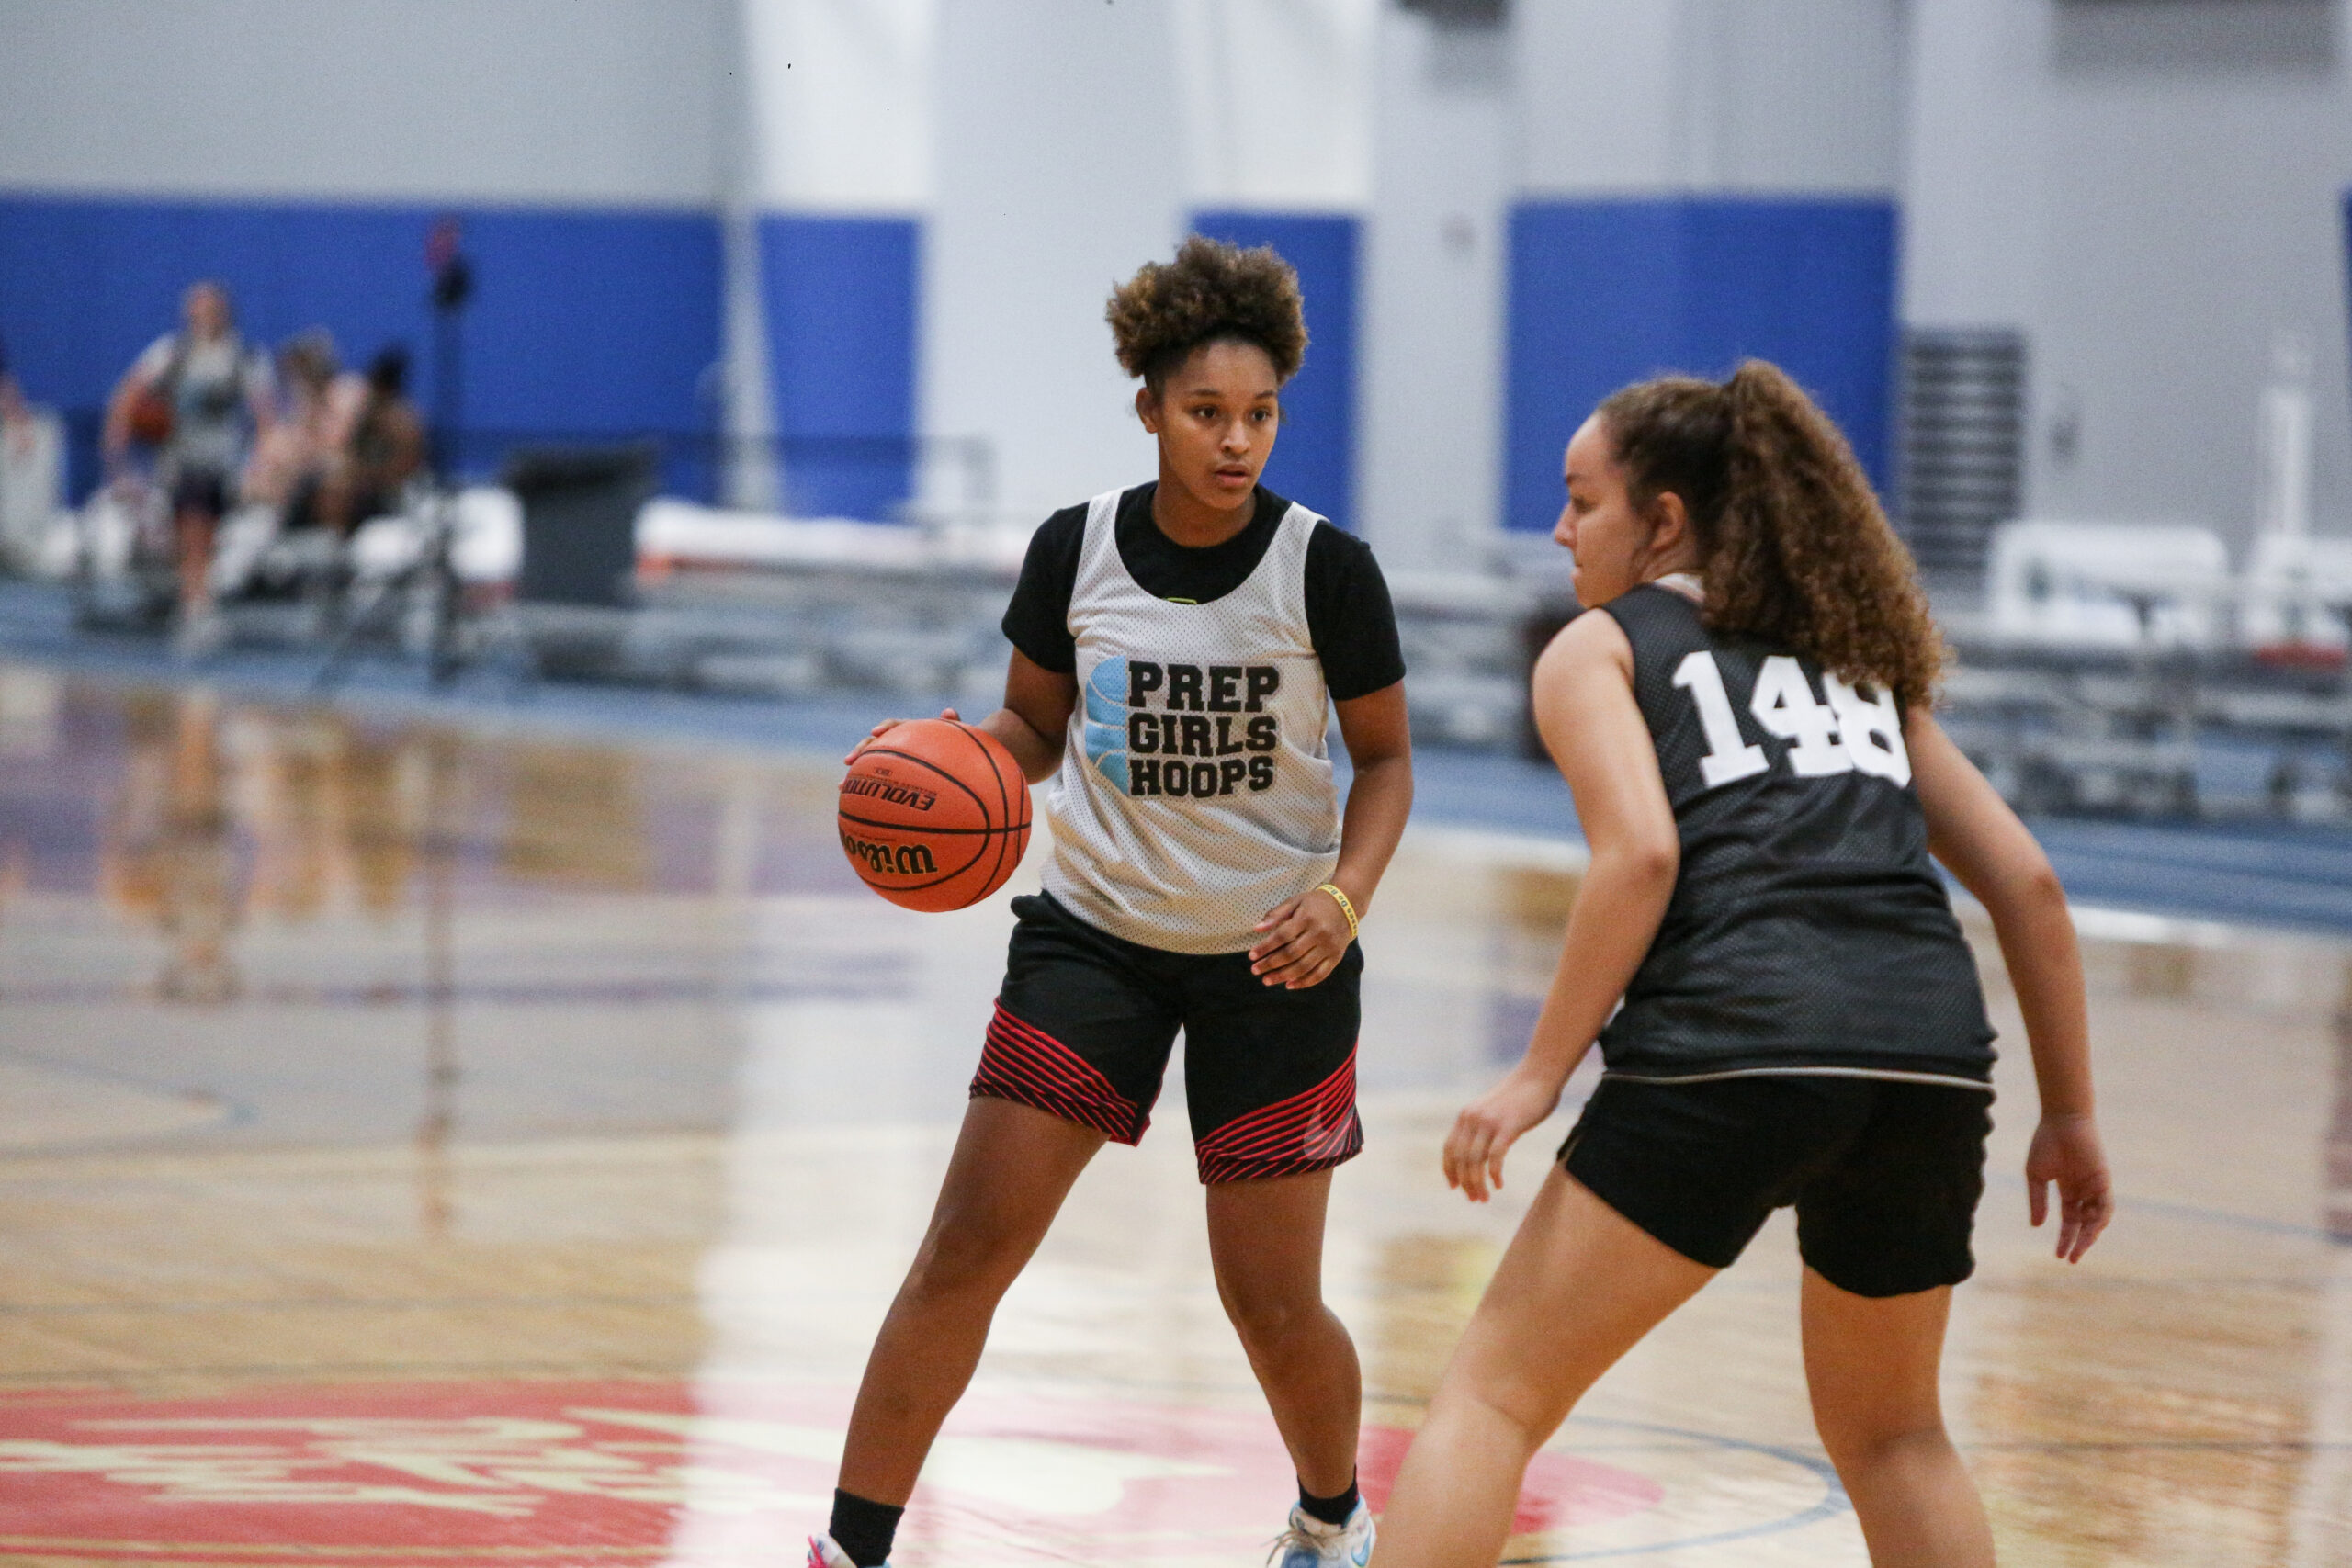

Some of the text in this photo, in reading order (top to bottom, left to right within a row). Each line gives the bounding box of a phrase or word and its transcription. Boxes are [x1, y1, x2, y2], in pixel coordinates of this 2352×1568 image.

[1128, 660, 1280, 713] PREP
[1128, 712, 1277, 757] GIRLS
[1670, 649, 1912, 789] 148
[1130, 755, 1274, 798] HOOPS
